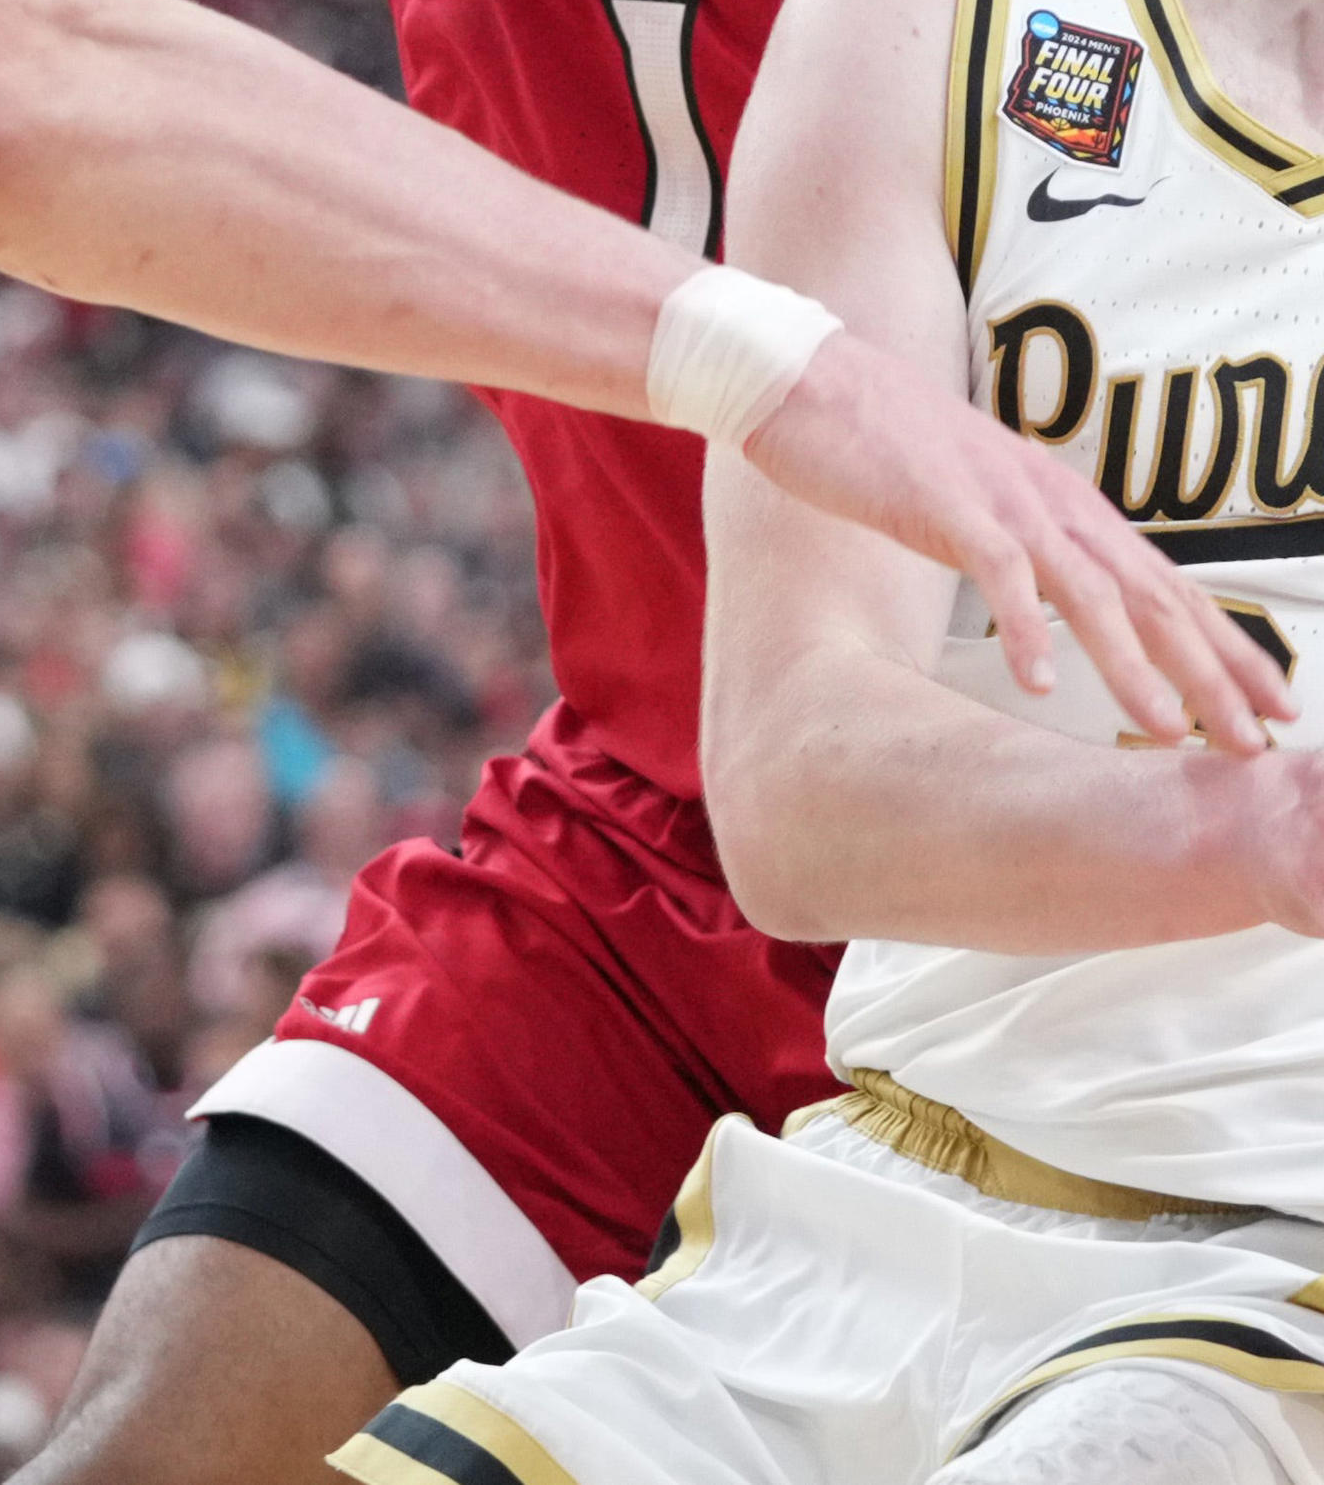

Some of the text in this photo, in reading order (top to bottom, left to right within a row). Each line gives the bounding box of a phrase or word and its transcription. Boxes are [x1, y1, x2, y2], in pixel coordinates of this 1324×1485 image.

[1061, 32, 1122, 56] 2024 MEN'S
[1034, 40, 1116, 84] FINAL
[1027, 66, 1110, 109] FOUR
[1034, 101, 1091, 124] PHOENIX
